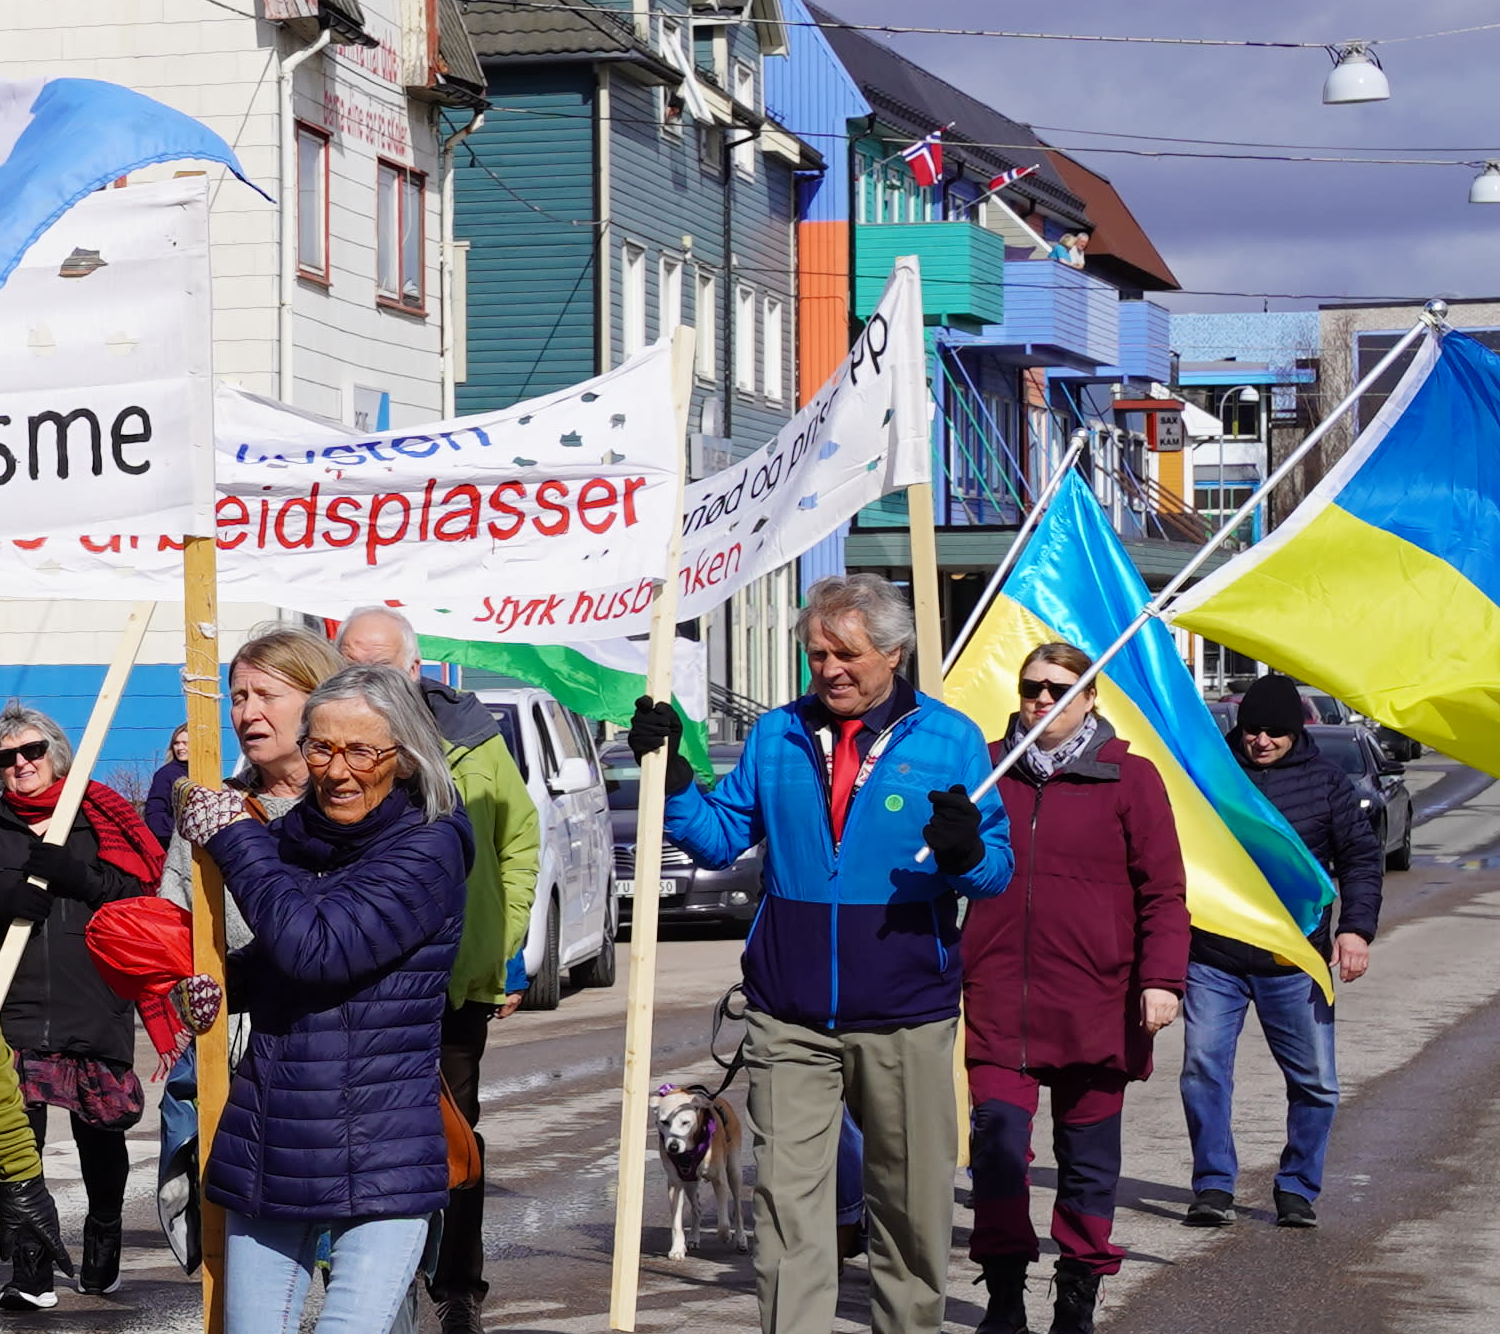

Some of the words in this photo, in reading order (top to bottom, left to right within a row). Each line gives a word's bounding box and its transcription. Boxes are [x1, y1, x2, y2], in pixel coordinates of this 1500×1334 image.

[1160, 416, 1179, 425] SAX
[1165, 427, 1173, 436] &
[1159, 437, 1180, 446] KAM
[474, 593, 564, 634] Styrk
[568, 543, 742, 624] husbnken
